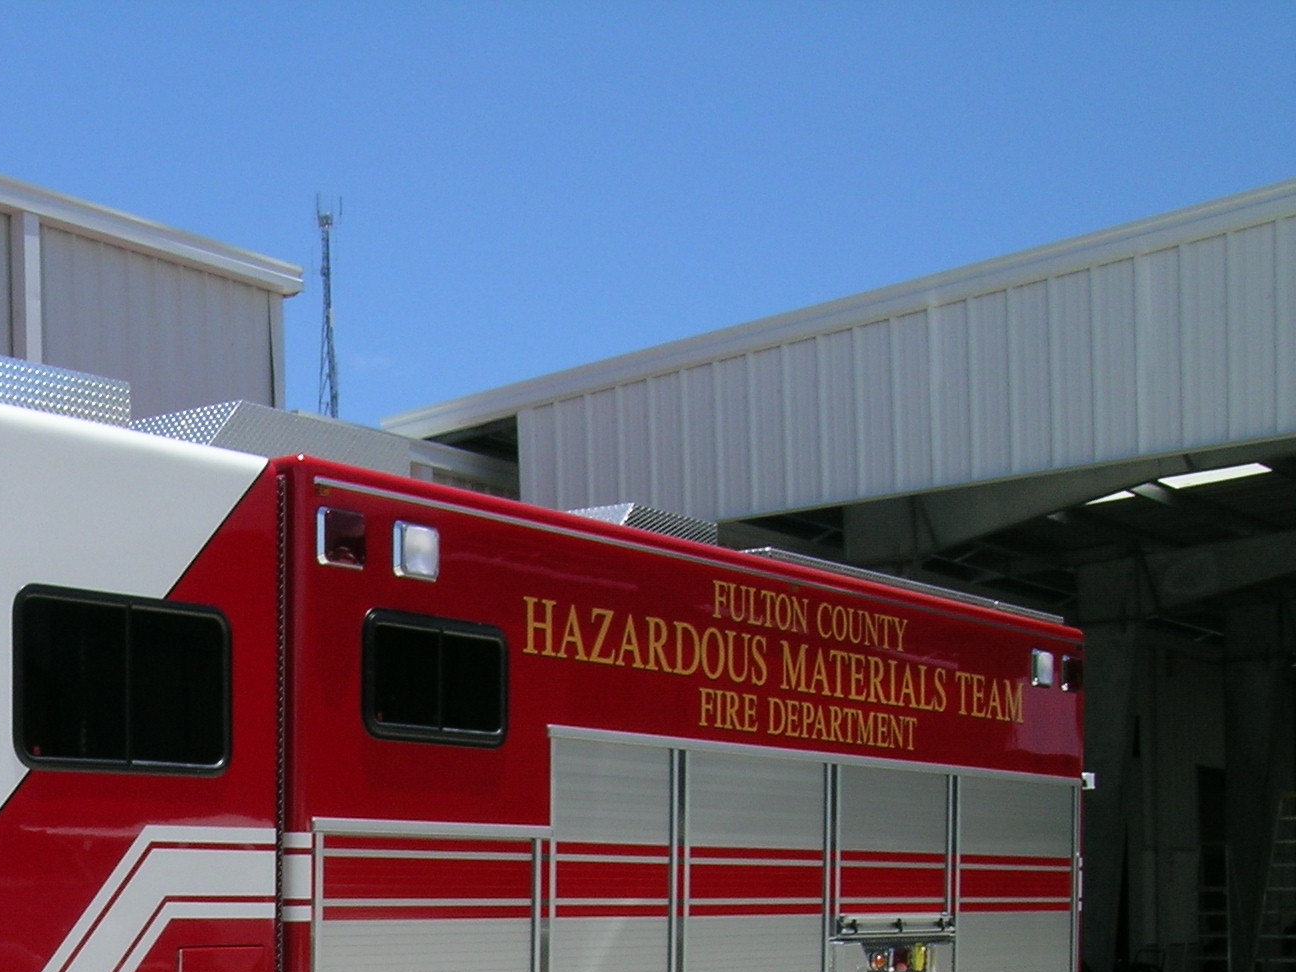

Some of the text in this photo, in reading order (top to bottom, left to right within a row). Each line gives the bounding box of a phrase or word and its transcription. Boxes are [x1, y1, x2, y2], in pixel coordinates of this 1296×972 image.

[713, 580, 908, 651] FULTON COUNTY
[523, 596, 1024, 723] HAZARDOUS MATERIALS TEAM
[699, 688, 917, 750] FIRE DEPARTMENT
